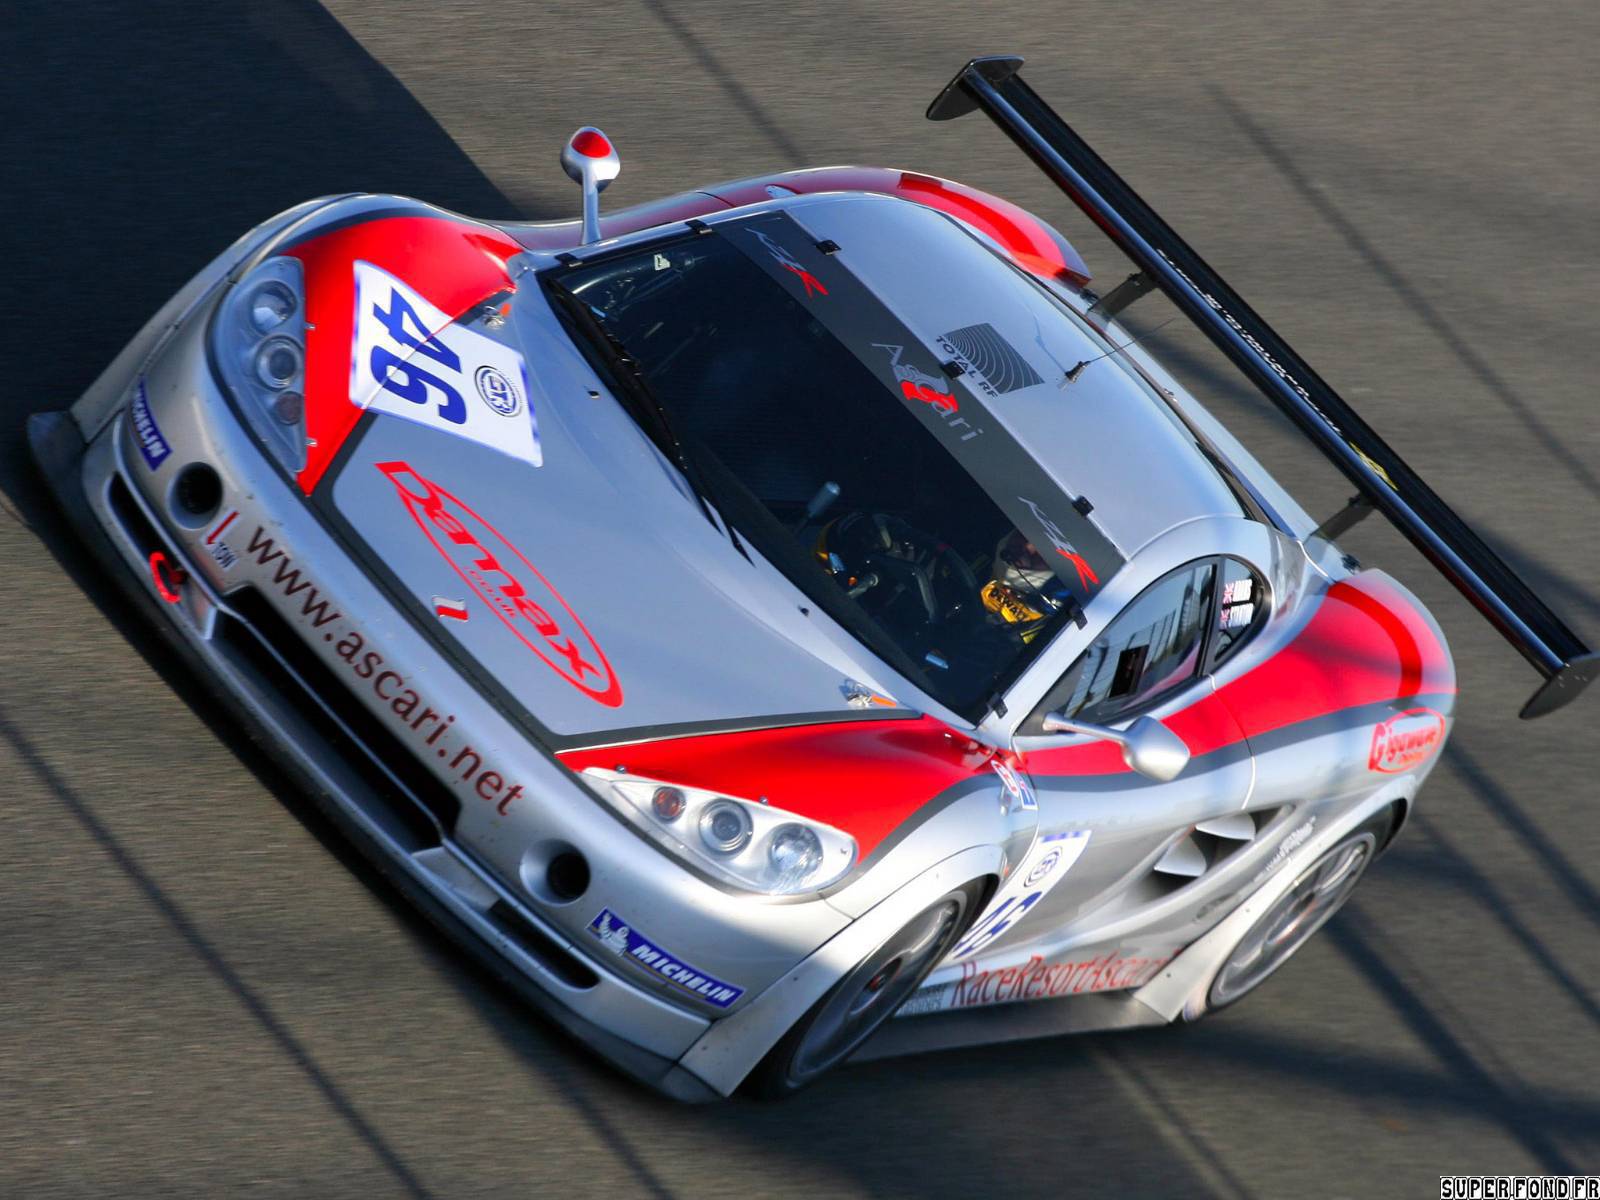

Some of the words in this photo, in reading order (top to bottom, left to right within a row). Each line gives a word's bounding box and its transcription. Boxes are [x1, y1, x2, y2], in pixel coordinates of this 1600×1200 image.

[368, 286, 470, 426] 46
[871, 342, 984, 442] Ascari
[935, 336, 979, 385] TOTAL
[976, 378, 1000, 400] RF
[211, 542, 236, 570] TOW
[376, 461, 603, 680] Damax
[247, 524, 524, 816] www.ascari.net
[632, 944, 737, 1004] MICHELIN
